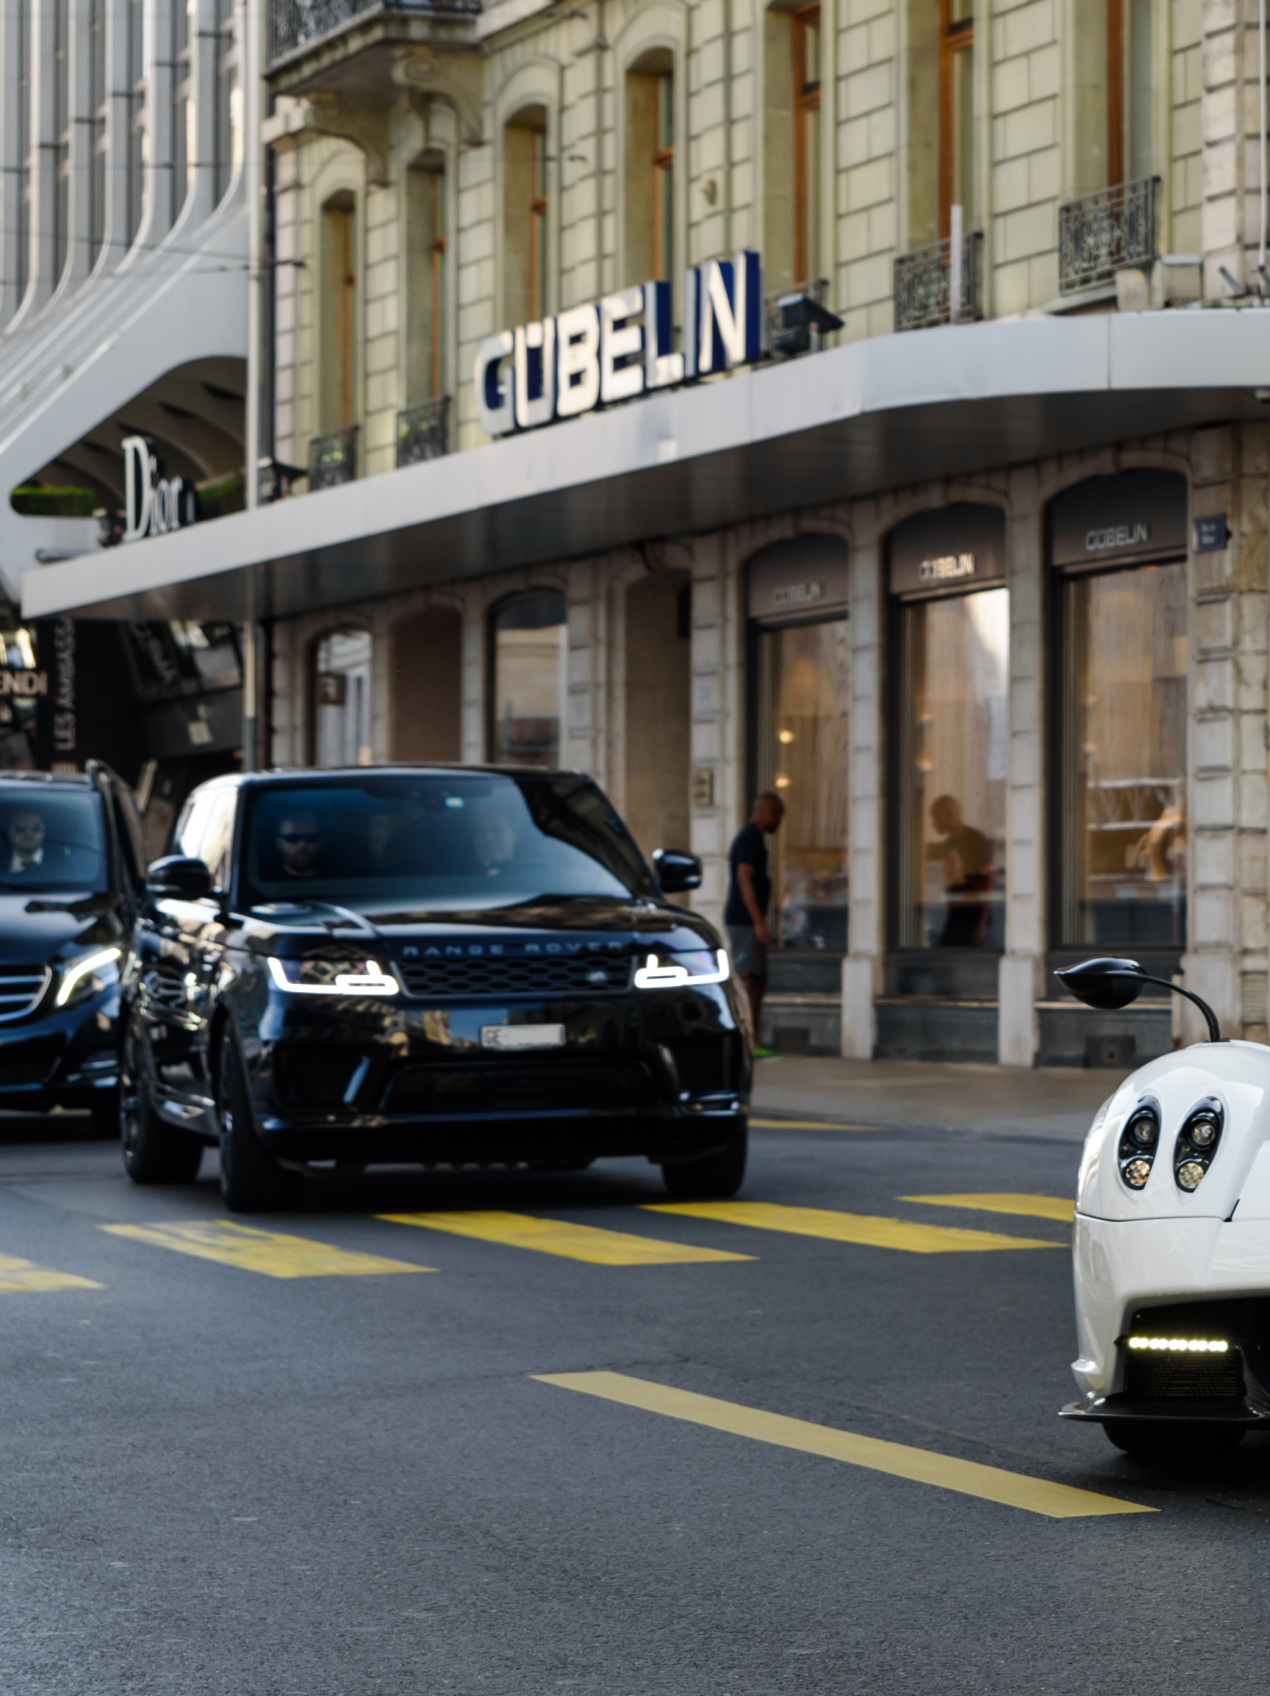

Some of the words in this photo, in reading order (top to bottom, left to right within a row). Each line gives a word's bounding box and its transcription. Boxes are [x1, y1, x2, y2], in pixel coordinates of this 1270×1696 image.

[121, 435, 183, 543] Dior
[403, 945, 504, 956] RANGE
[525, 941, 624, 953] ROVER
